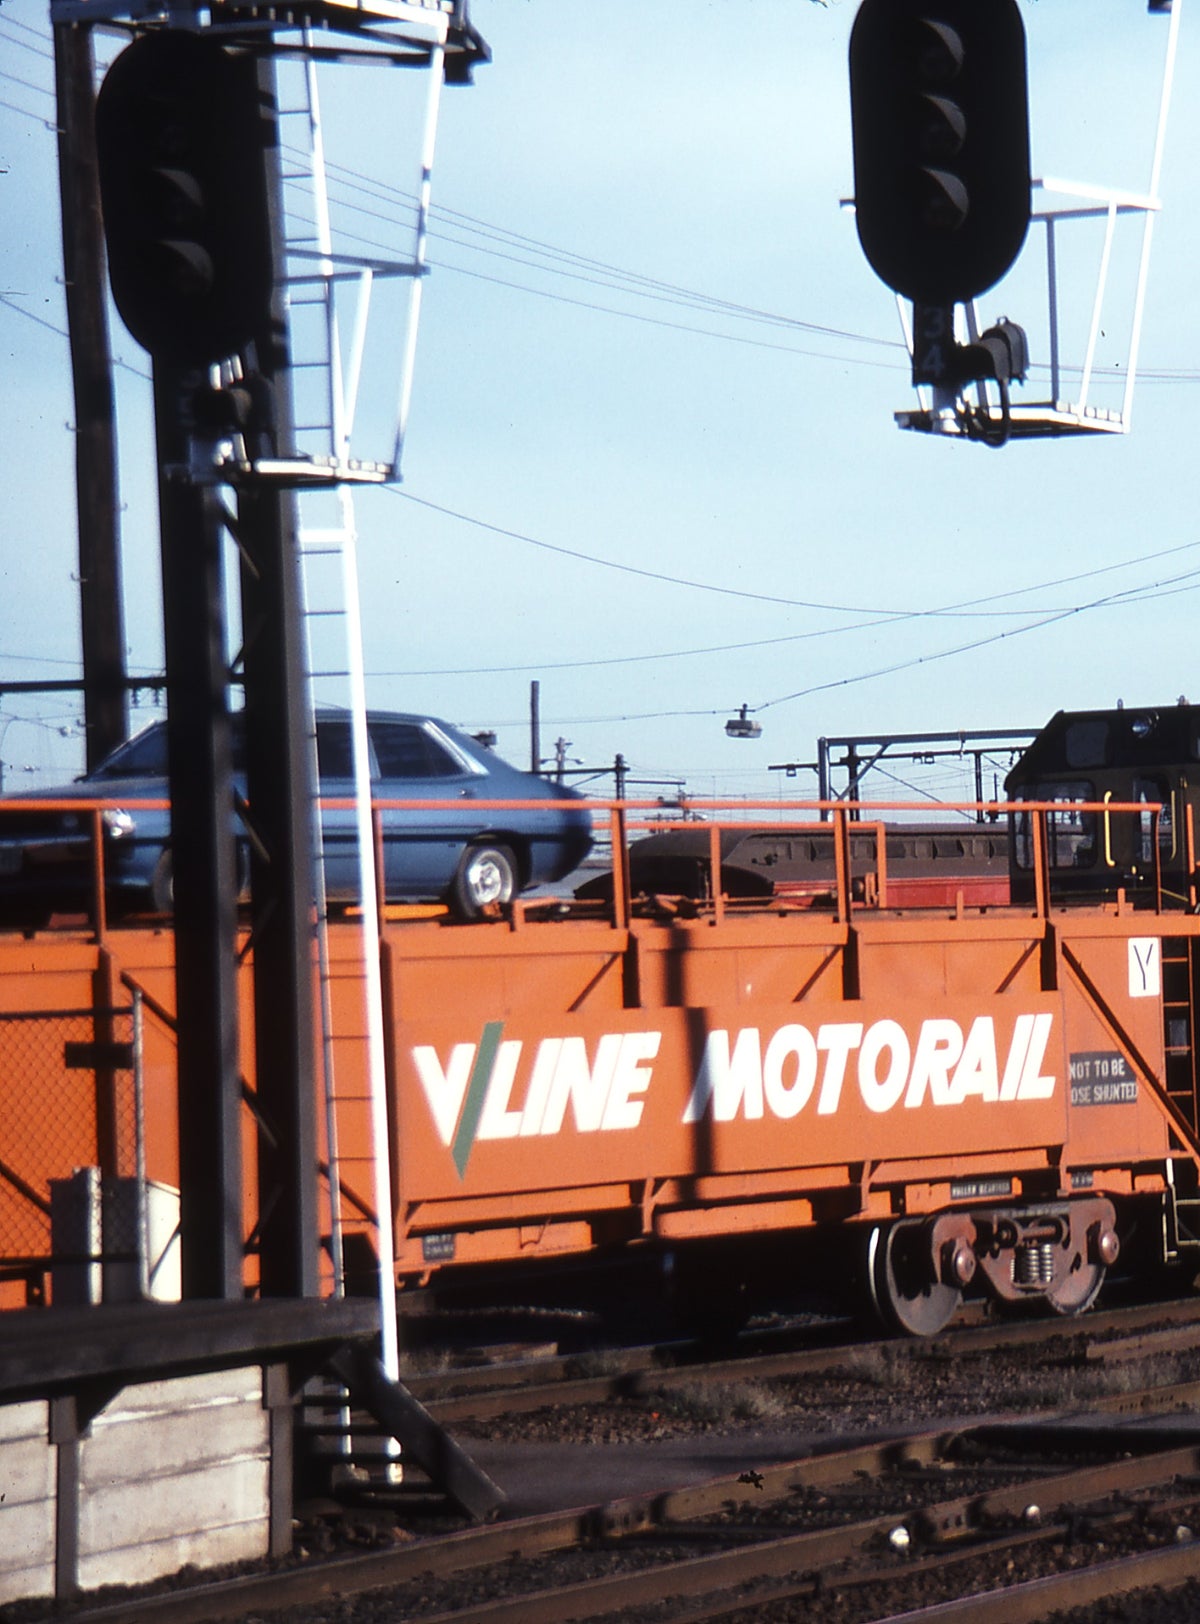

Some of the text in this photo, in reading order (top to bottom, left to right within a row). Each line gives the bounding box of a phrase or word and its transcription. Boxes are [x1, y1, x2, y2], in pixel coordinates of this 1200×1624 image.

[1133, 943, 1154, 991] Y
[681, 1013, 1056, 1124] MOTORAIL
[1070, 1058, 1126, 1079] NOT TO BE
